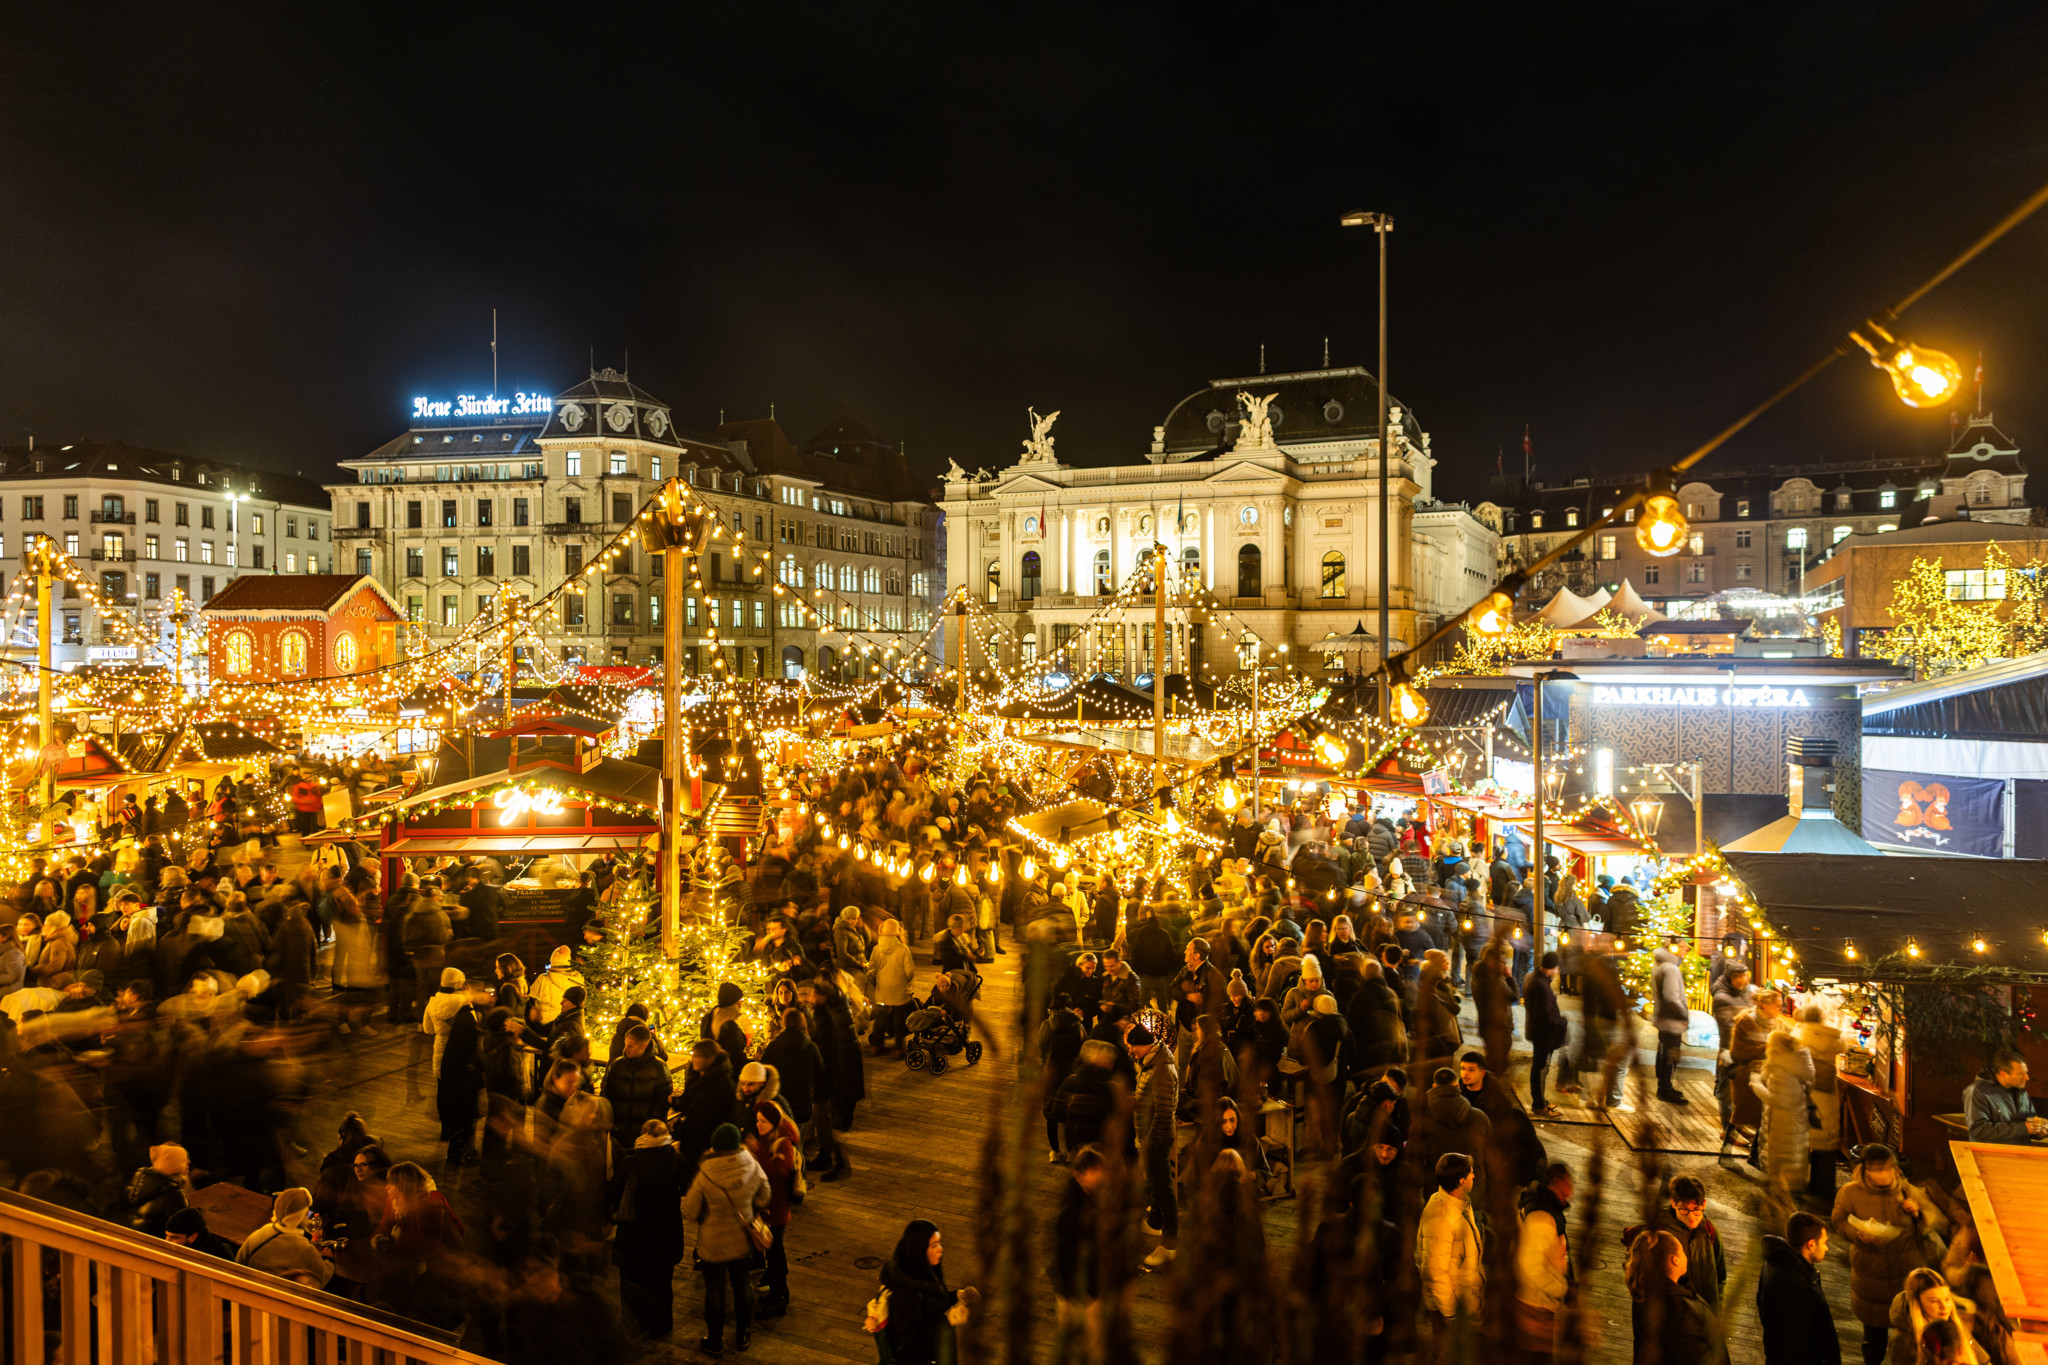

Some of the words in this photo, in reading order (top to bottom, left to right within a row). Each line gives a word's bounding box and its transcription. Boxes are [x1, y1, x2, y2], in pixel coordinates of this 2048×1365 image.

[413, 396, 451, 418] Neue
[453, 393, 510, 416] Zürcher
[1593, 685, 1717, 706] PARKHAUS
[1721, 685, 1811, 707] OPÉRA
